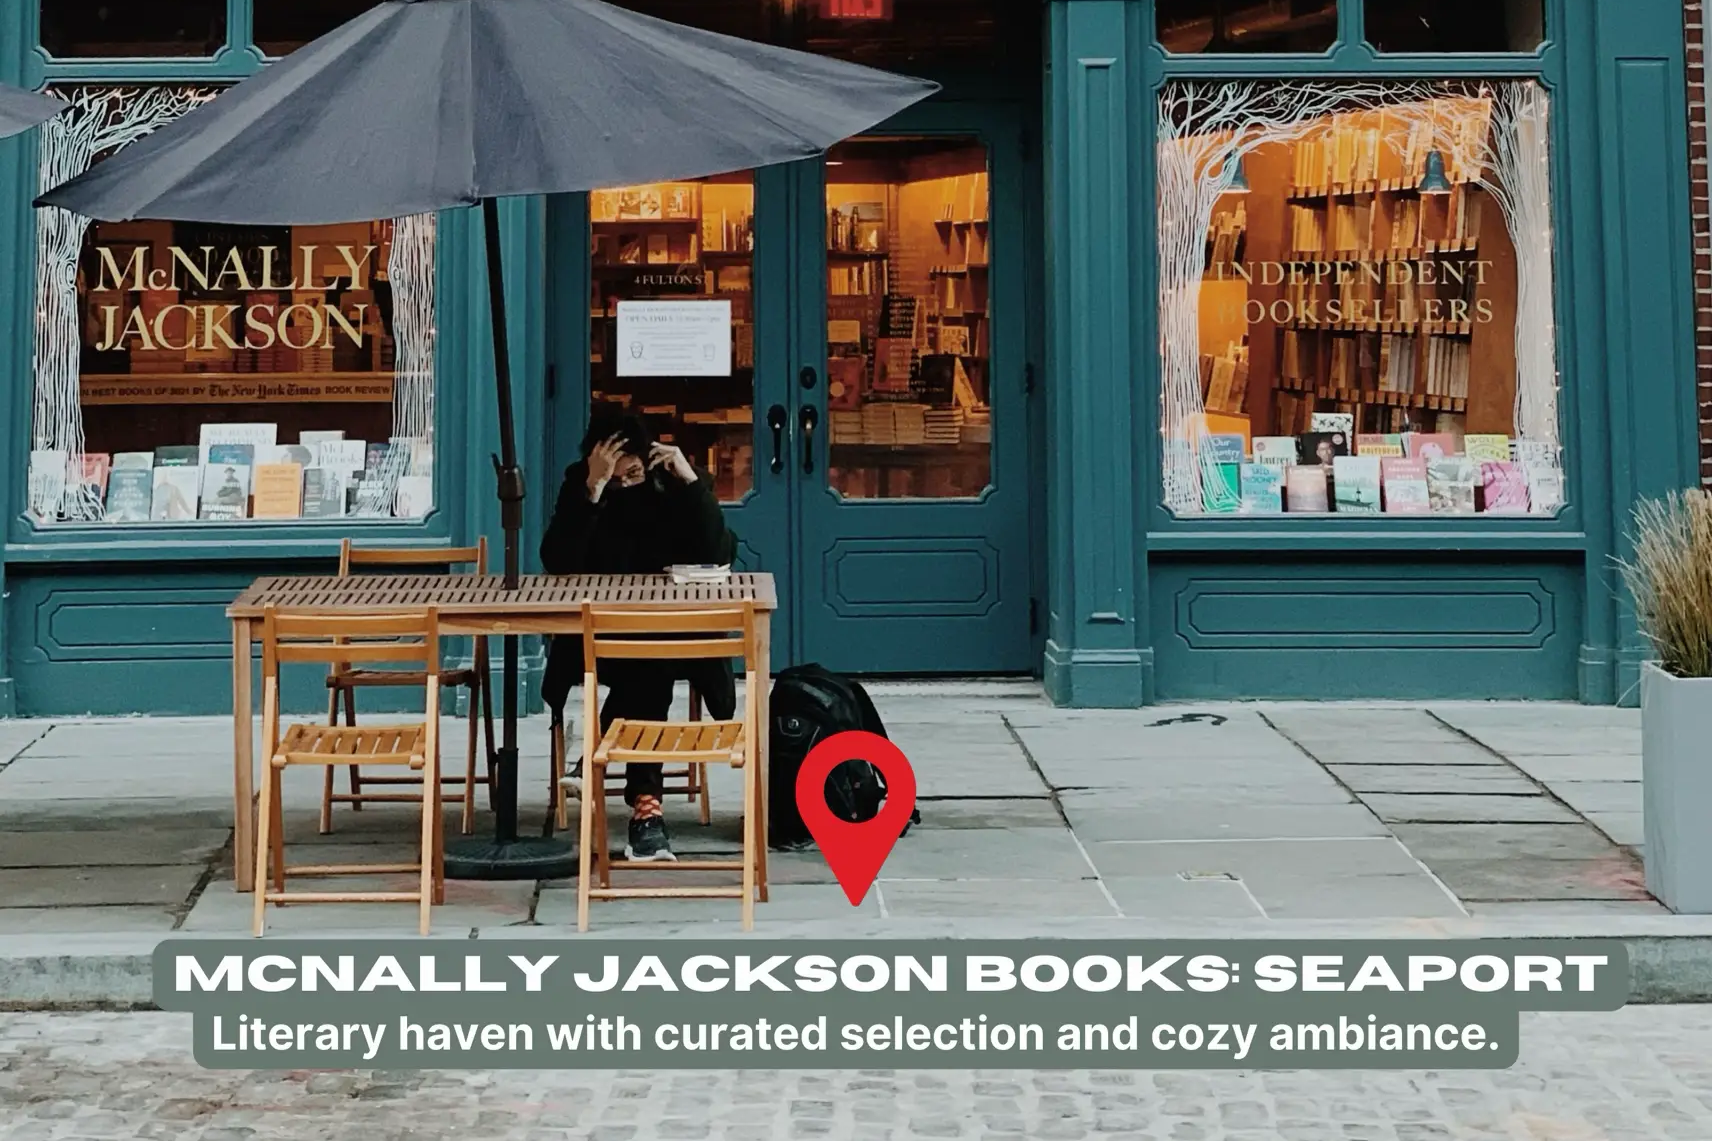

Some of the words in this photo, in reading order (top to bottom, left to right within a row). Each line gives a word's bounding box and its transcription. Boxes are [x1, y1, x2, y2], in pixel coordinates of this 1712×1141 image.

[94, 245, 377, 291] McNALLY
[1216, 260, 1494, 286] INDEPENDENT
[642, 274, 694, 285] FULTON
[96, 303, 369, 351] JACKSON
[91, 387, 117, 396] BEST
[118, 386, 152, 396] BOOKS
[154, 386, 168, 396] OF
[192, 386, 206, 395] BY
[209, 384, 230, 398] The
[231, 384, 256, 396] New
[257, 383, 285, 399] York
[287, 383, 321, 396] Times
[325, 385, 353, 395] BOOK
[354, 385, 391, 395] REVIEW
[1211, 438, 1231, 446] Our
